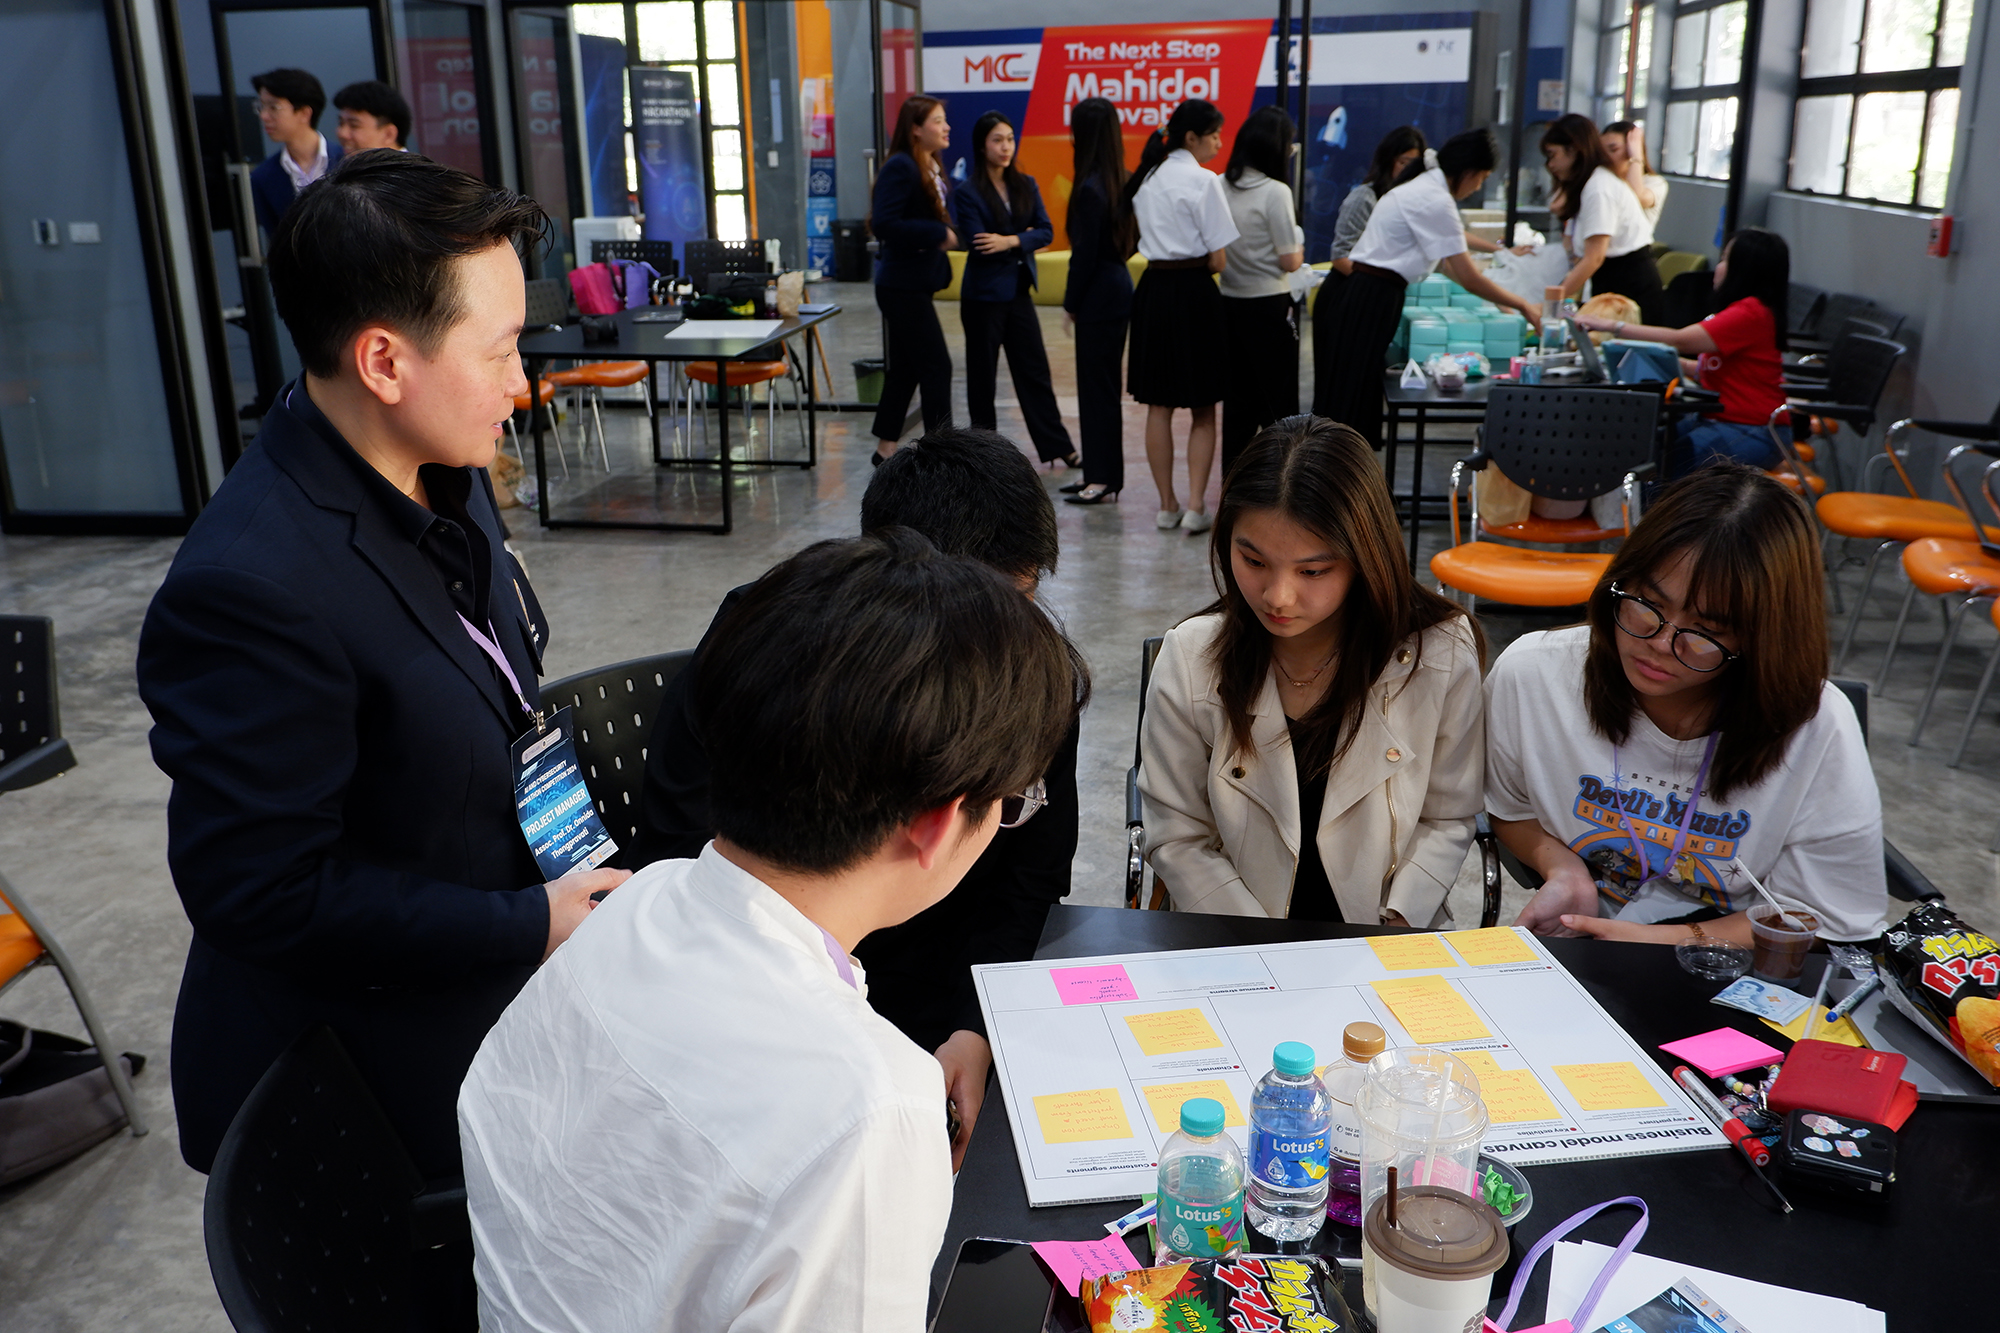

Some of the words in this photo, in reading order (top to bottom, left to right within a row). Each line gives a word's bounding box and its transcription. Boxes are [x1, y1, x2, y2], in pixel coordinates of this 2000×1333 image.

[1064, 42, 1105, 61] The
[1109, 41, 1162, 60] Next
[1166, 40, 1221, 62] Step
[1133, 60, 1146, 70] of
[1064, 68, 1219, 102] Mahidol
[536, 760, 567, 785] CYBERSECURITY
[518, 788, 542, 809] HACKATHON
[541, 771, 568, 792] COMPETITION
[1631, 772, 1708, 797] STEREO
[525, 809, 555, 837] PROJECT
[554, 788, 586, 817] MANAGER
[1579, 776, 1662, 819] Devil's
[1662, 793, 1749, 839] Music
[535, 840, 554, 857] Assoc.
[552, 829, 567, 842] Prof.
[565, 824, 575, 833] Dr.
[574, 809, 594, 826] Onnida
[1582, 805, 1727, 853] SING-ALNG!
[551, 826, 589, 859] Thongpravati
[1559, 1132, 1623, 1148] model
[1625, 1125, 1713, 1143] Business
[1272, 1138, 1325, 1154] Lotus's
[1483, 1139, 1558, 1155] canvas
[1066, 1166, 1108, 1174] segments
[1109, 1163, 1150, 1171] Customer
[1176, 1205, 1232, 1222] Lotus's
